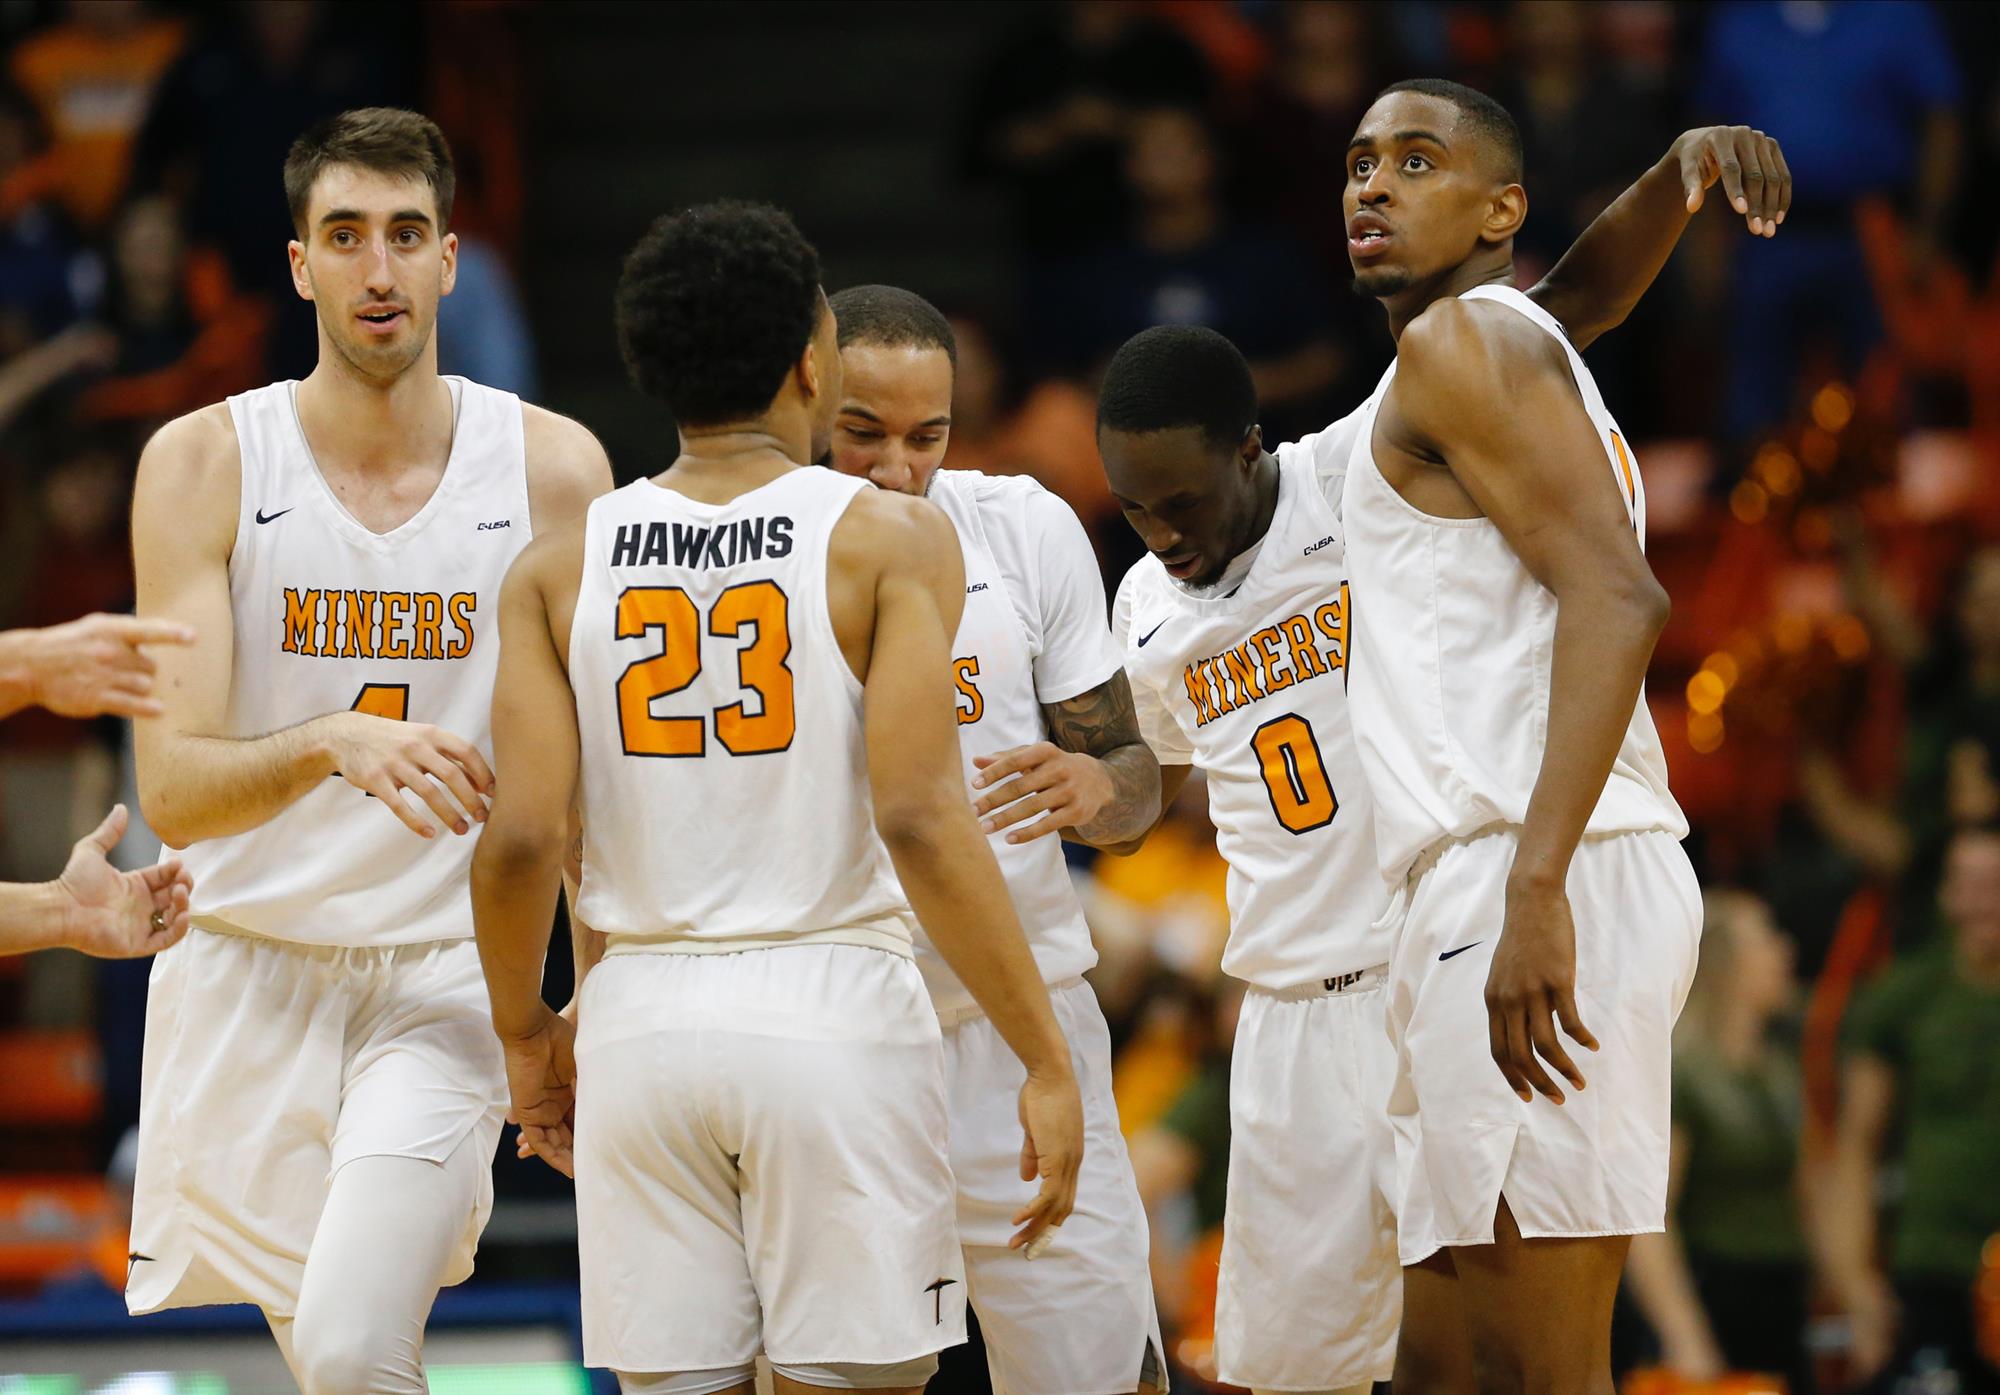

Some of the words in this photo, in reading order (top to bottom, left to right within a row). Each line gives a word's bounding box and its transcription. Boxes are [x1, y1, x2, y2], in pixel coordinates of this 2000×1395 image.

[610, 516, 794, 571] HAWKINS
[966, 582, 989, 594] USA
[281, 587, 477, 660] MINERS
[614, 578, 796, 758] 23
[1183, 599, 1342, 728] MINERS
[1249, 711, 1340, 836] 0
